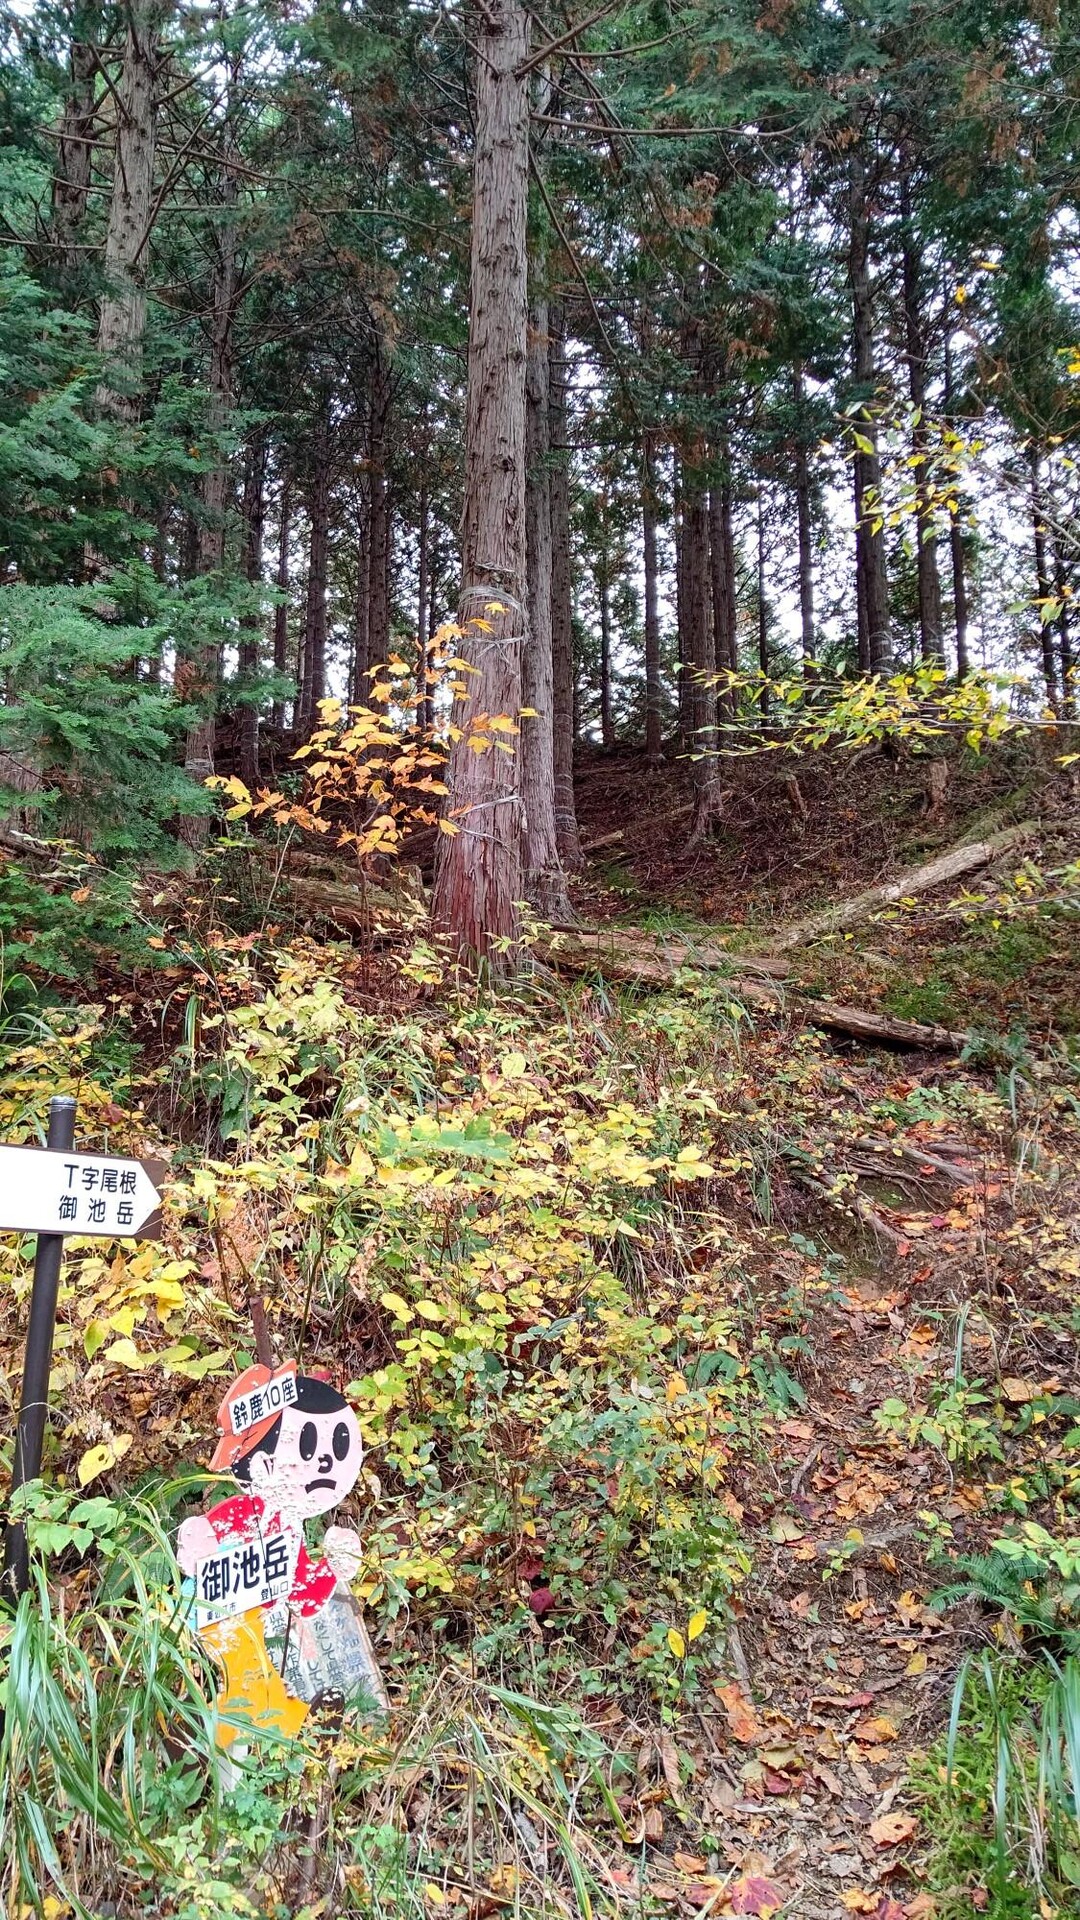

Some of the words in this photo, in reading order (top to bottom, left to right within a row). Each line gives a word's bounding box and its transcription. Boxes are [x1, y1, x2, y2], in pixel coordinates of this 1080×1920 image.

[64, 1164, 137, 1195] T字尾根
[58, 1195, 134, 1224] 御池岳
[233, 1377, 296, 1429] 鈴鹿10座
[201, 1535, 290, 1601] 御池岳
[261, 1580, 289, 1600] 登山口
